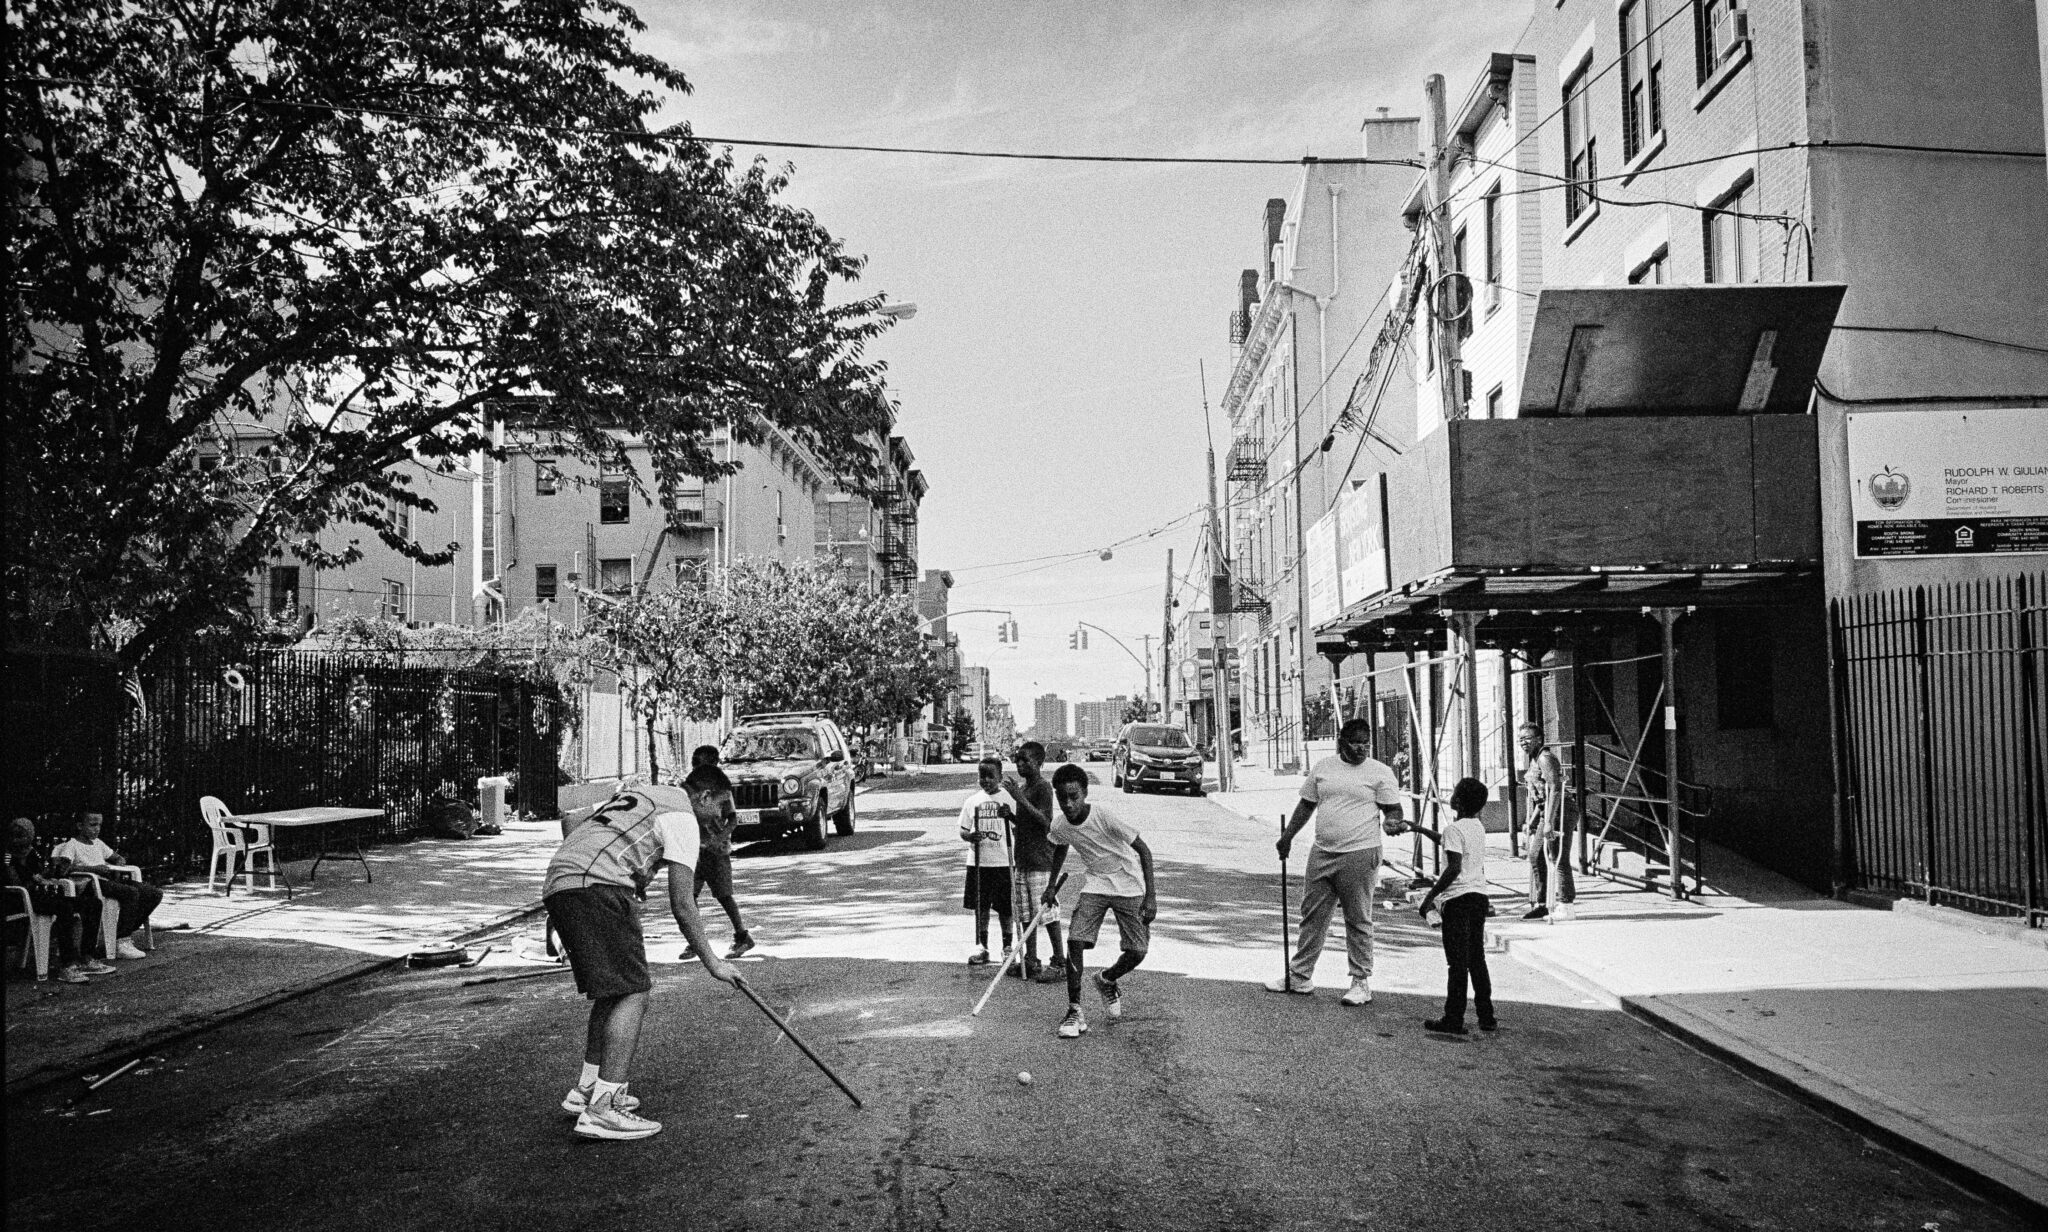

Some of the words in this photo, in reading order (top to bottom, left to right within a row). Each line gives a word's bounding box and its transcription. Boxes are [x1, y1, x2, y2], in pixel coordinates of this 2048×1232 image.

[1945, 468, 1994, 477] RUDOLPH
[1945, 478, 1968, 486] Mayor
[1946, 486, 1988, 495] RICHARD
[2001, 485, 2044, 494] ROBERTS
